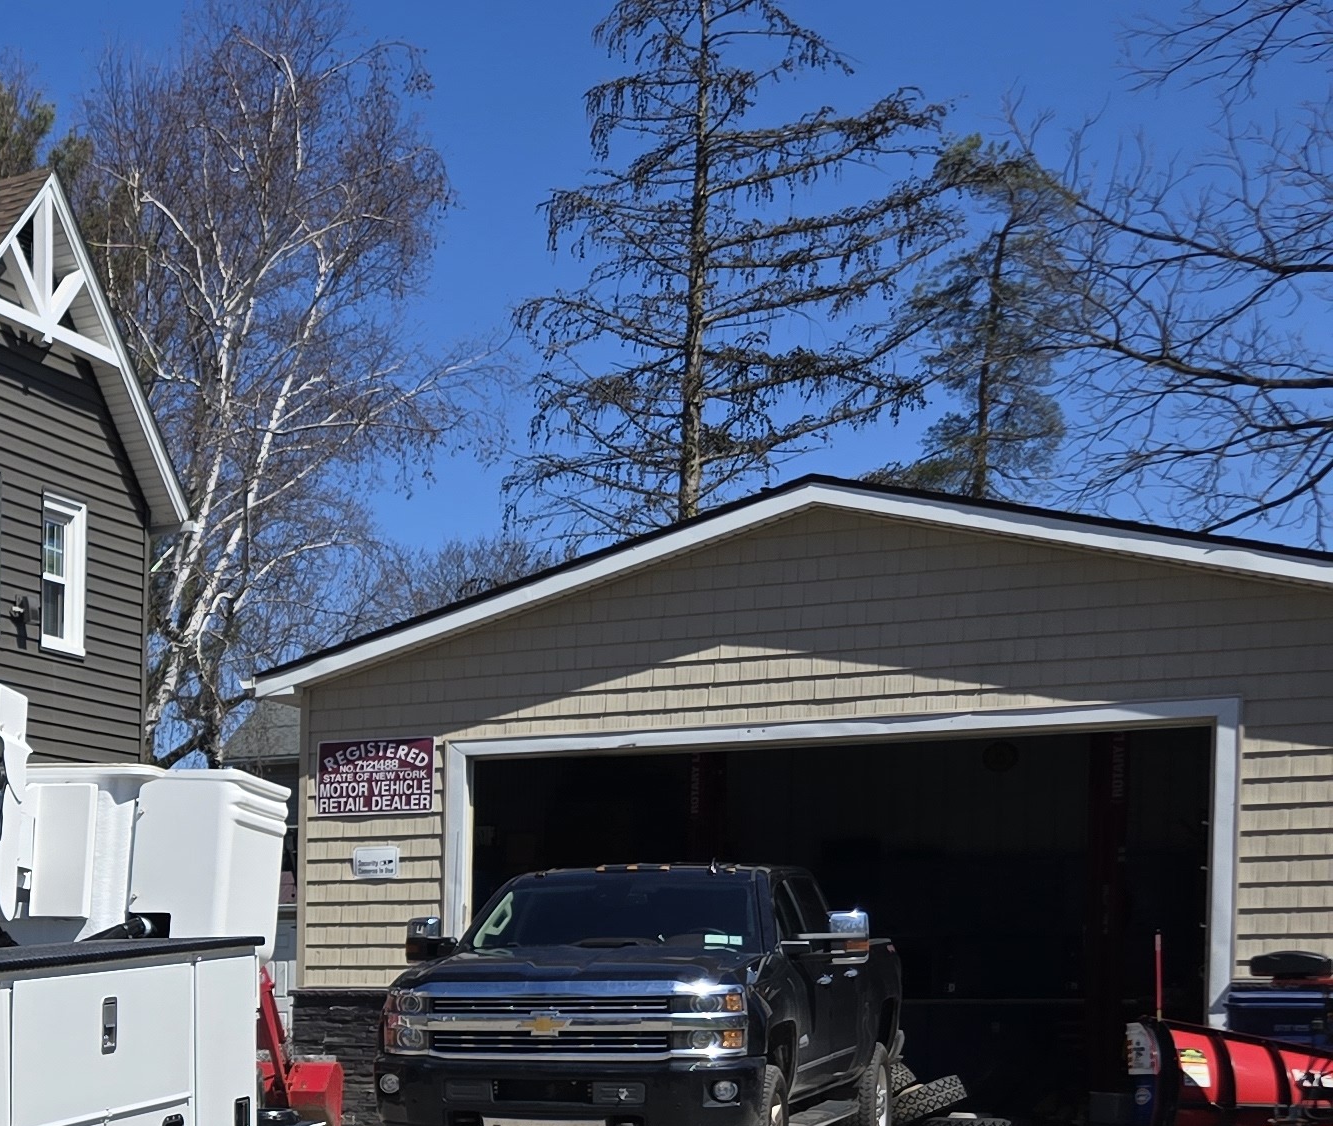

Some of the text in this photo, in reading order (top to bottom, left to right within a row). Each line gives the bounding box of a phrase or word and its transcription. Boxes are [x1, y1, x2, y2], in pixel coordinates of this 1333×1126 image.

[323, 742, 429, 772] REGISTERED
[322, 769, 427, 783] STATE OF NEW YORK
[339, 764, 354, 773] NO.
[319, 779, 431, 798] MOTOR VEHICLE
[319, 795, 430, 813] RETAIL DEALER
